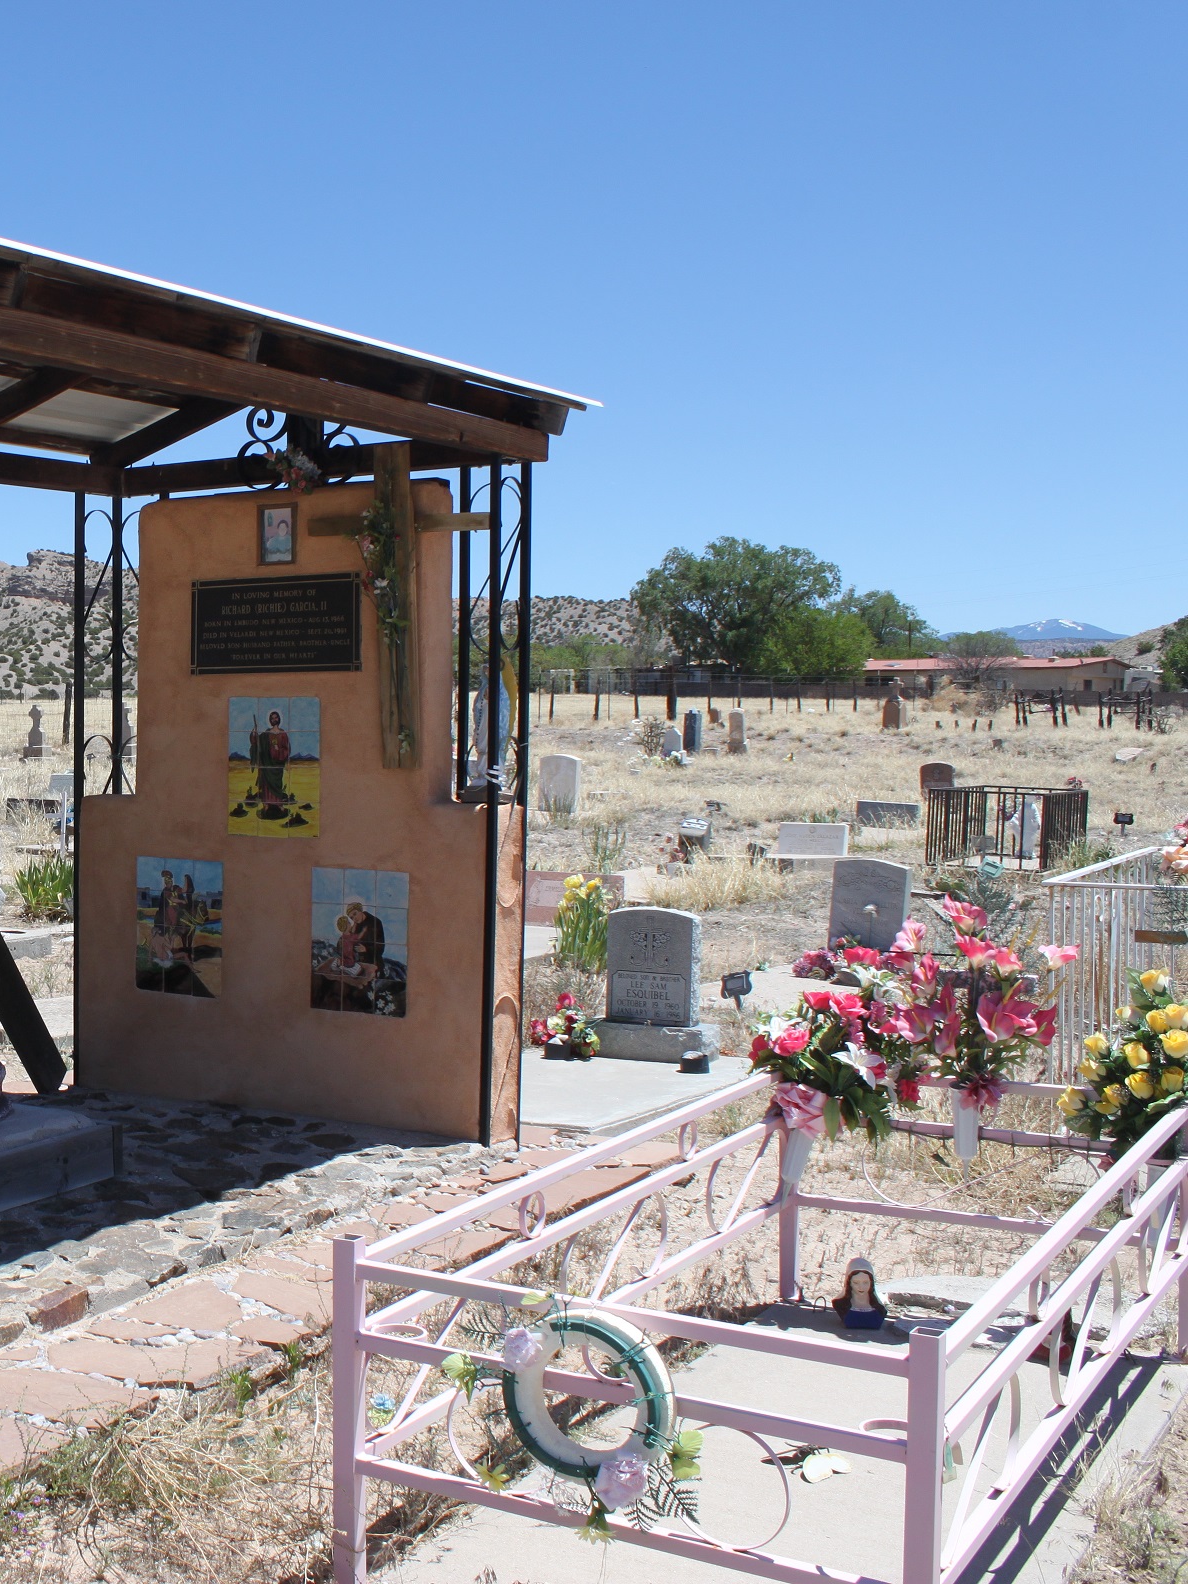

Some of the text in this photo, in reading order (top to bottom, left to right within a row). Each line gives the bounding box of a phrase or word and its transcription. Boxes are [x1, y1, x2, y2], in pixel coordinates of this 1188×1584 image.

[243, 591, 270, 600] LOVING
[273, 589, 303, 598] MEMORY
[306, 588, 317, 597] OF
[221, 604, 251, 615] RICHARD
[254, 601, 287, 615] (RICHIE)
[204, 620, 222, 628] BORN
[224, 619, 232, 627] IN
[202, 631, 218, 640] DIED
[229, 630, 257, 638] VELARDE
[276, 628, 300, 636] MEXICO
[199, 642, 225, 650] BELOVED
[263, 652, 271, 660] IN
[617, 972, 638, 980] BELOVED
[660, 975, 681, 983] BROTHER
[630, 980, 667, 990] LEE SAM
[626, 988, 671, 1001] ESQUIBEL
[616, 998, 647, 1008] OCTOBER
[615, 1007, 648, 1017] JANUARY
